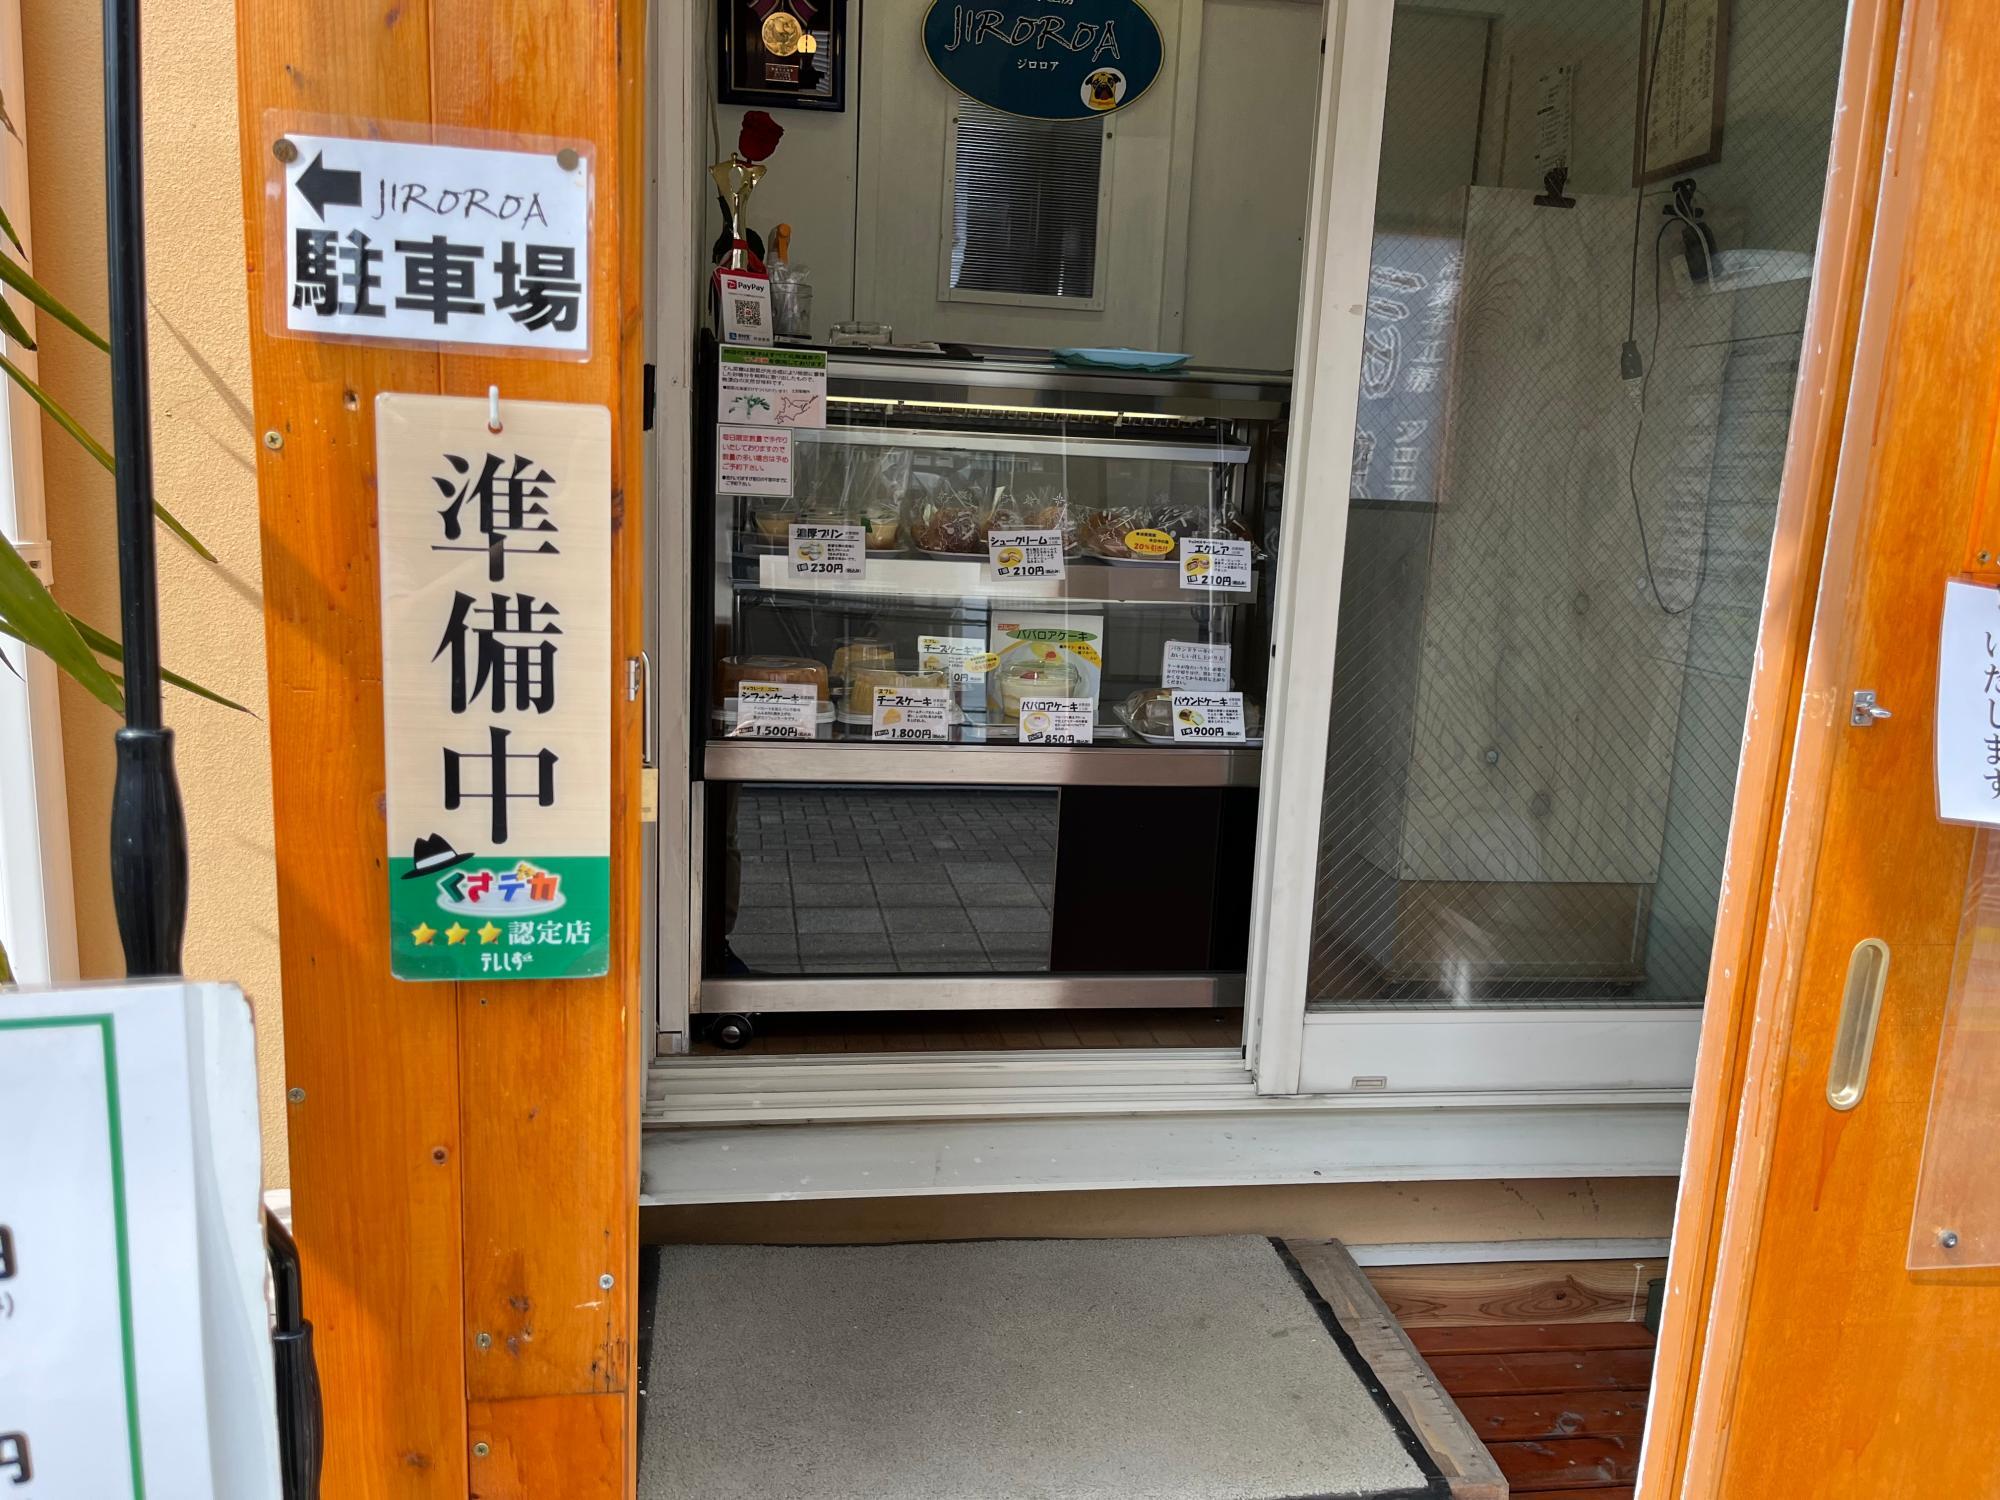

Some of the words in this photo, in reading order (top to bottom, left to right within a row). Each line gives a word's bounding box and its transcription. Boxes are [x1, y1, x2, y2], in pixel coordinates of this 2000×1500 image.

[945, 5, 1120, 62] JIROROA
[1017, 58, 1060, 70] ジロロア
[372, 179, 548, 229] JIROROA
[292, 227, 582, 333] 駐車場
[738, 281, 764, 293] PayPay
[797, 528, 843, 538] 濃厚プリン
[990, 536, 1047, 545] シュークリーム
[1194, 545, 1230, 555] エクレア
[811, 563, 843, 573] 230円
[1013, 566, 1044, 575] 210円
[1201, 575, 1231, 586] 210円
[431, 452, 563, 845] 準備中
[741, 692, 800, 703] シフォンケーキ
[877, 695, 932, 706] チーズケーキ
[1174, 696, 1228, 706] パウンドケーキ
[1194, 727, 1224, 736] 900円
[1045, 734, 1075, 744] 850円
[440, 872, 558, 903] くさデカ
[507, 920, 591, 945] 認定店
